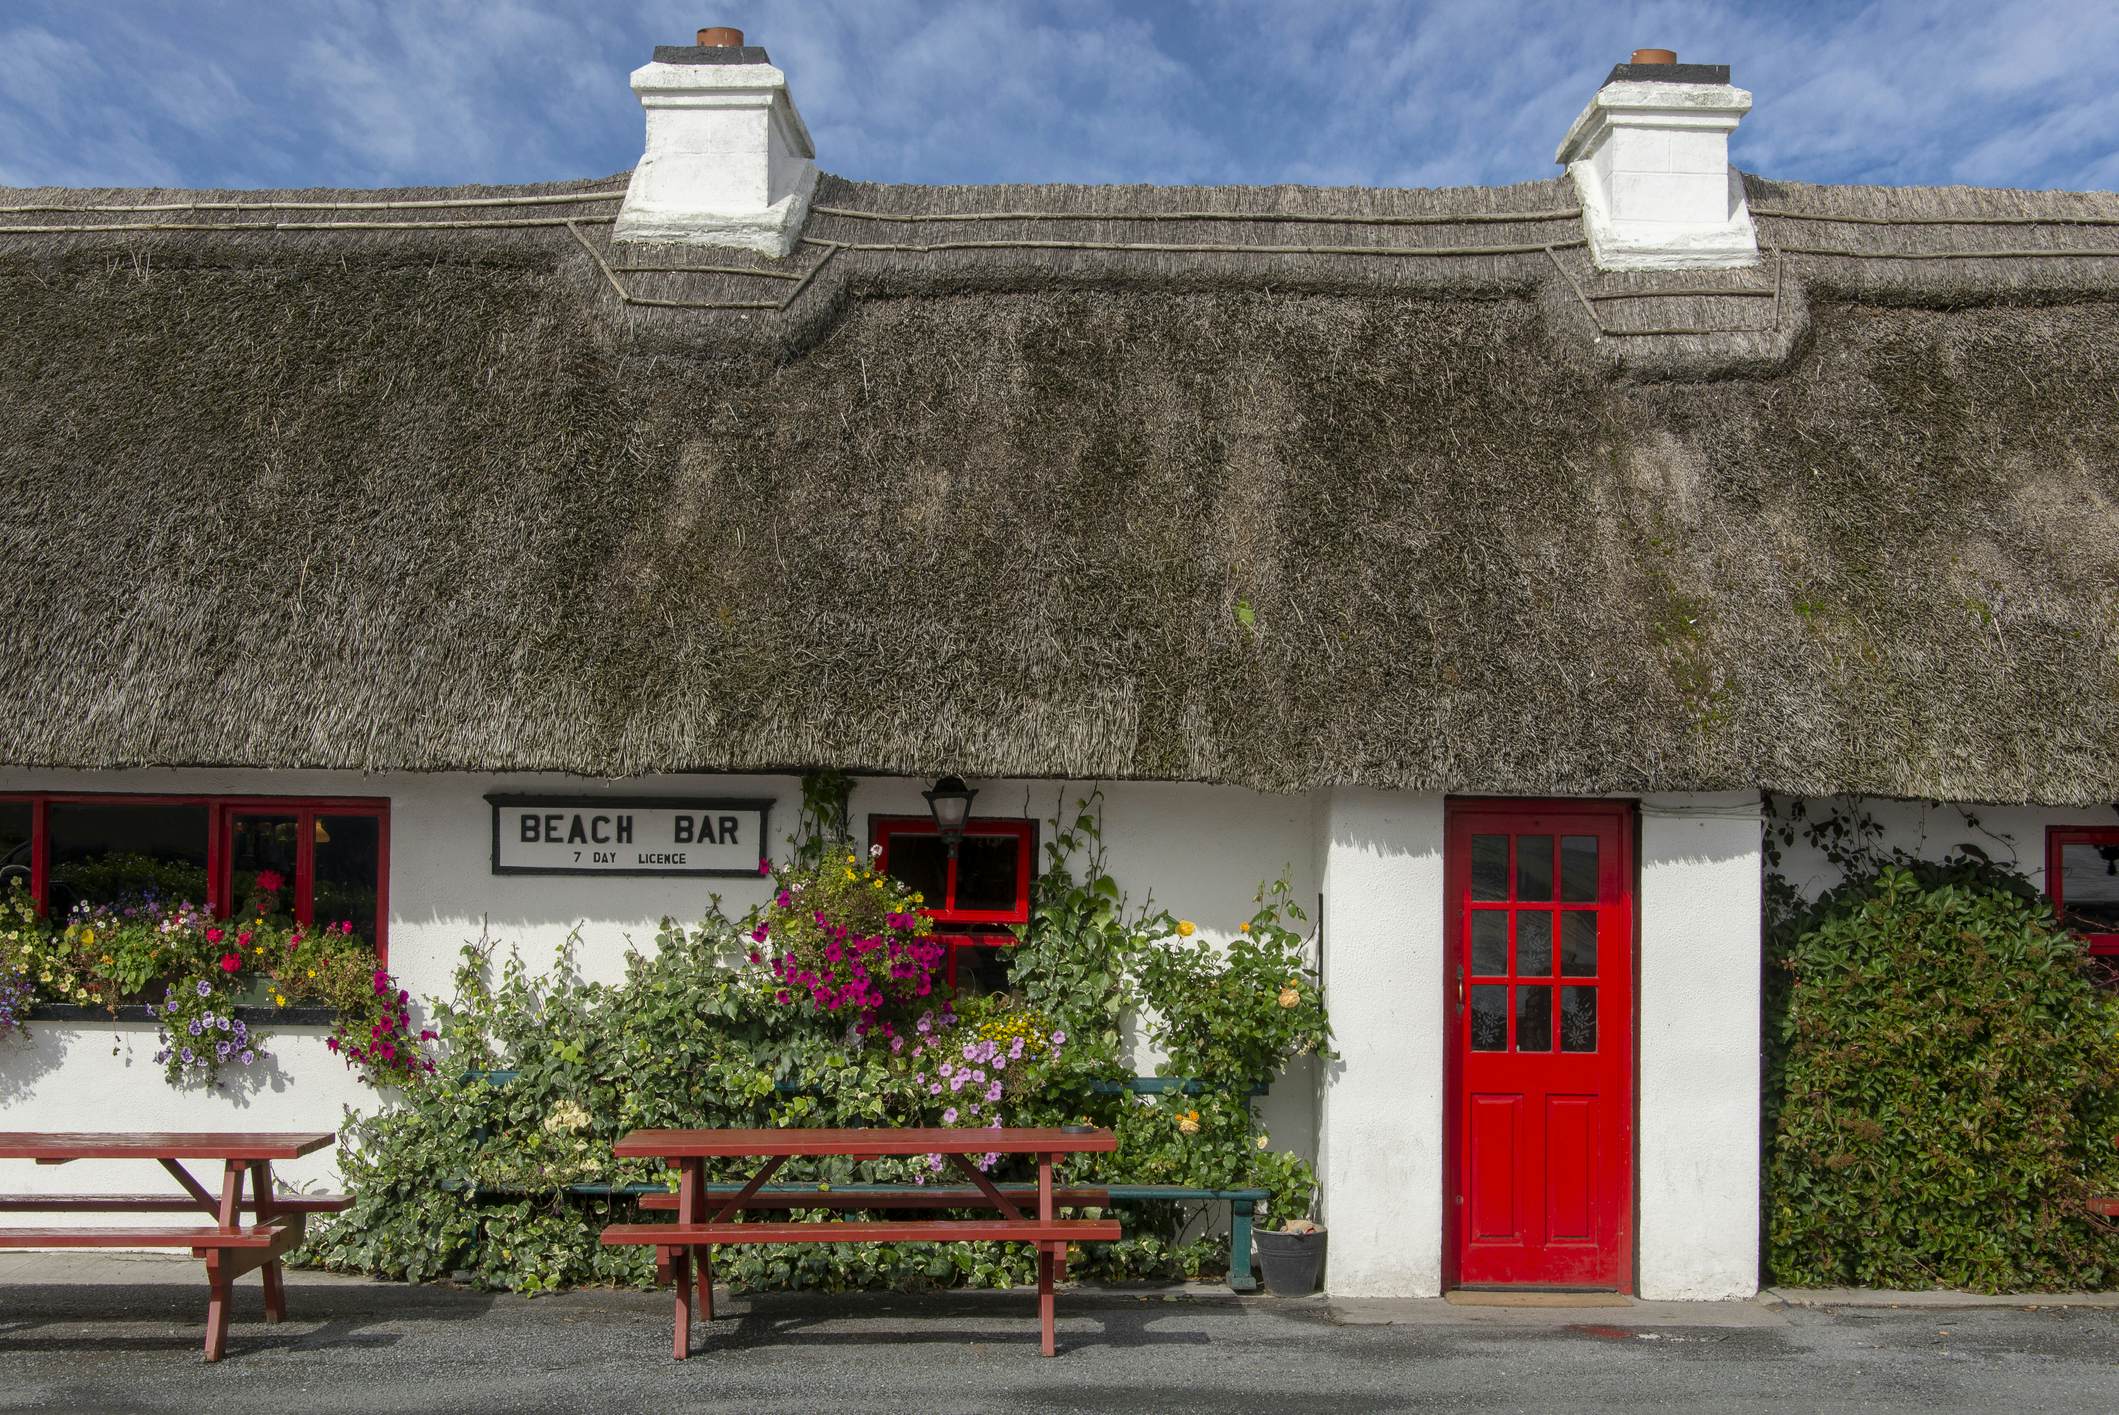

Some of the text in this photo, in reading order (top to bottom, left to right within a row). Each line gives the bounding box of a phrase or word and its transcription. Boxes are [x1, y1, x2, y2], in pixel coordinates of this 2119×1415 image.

[520, 814, 739, 844] BEACH BAR
[573, 851, 687, 865] 7 DAY LICENCE
